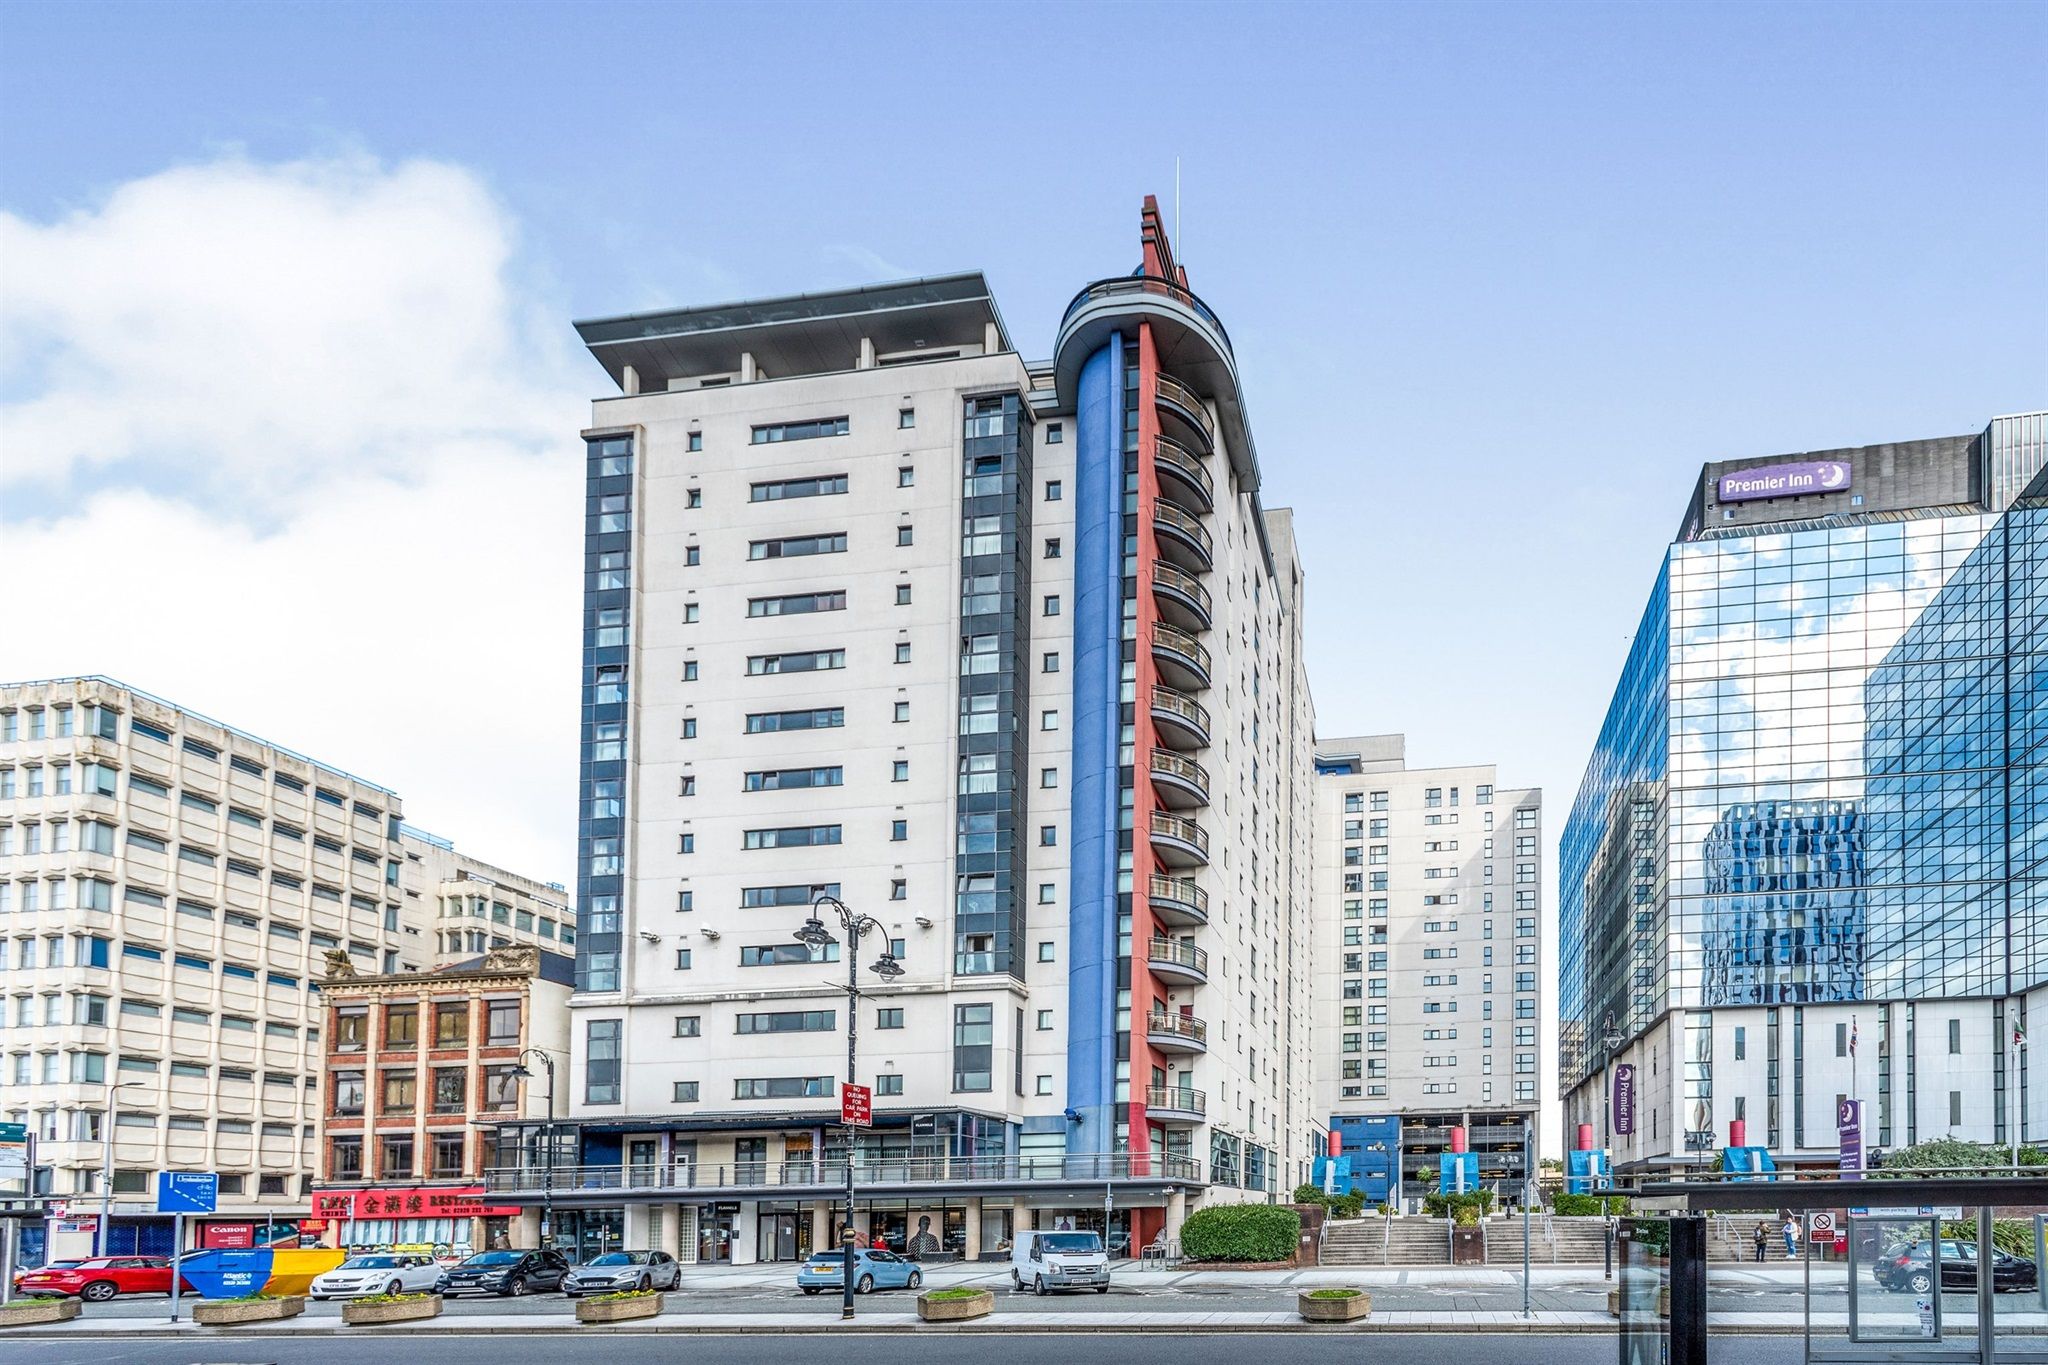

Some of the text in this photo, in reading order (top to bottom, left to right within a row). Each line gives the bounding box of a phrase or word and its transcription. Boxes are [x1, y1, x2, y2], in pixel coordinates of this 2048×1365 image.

[1726, 473, 1813, 494] Premier Inn
[851, 1098, 862, 1106] FOR
[844, 1103, 869, 1113] CAR PARK
[1620, 1082, 1630, 1132] Premier Inn
[856, 1118, 870, 1126] ROAD
[210, 1226, 248, 1234] Canon
[222, 1272, 247, 1280] Atlantic
